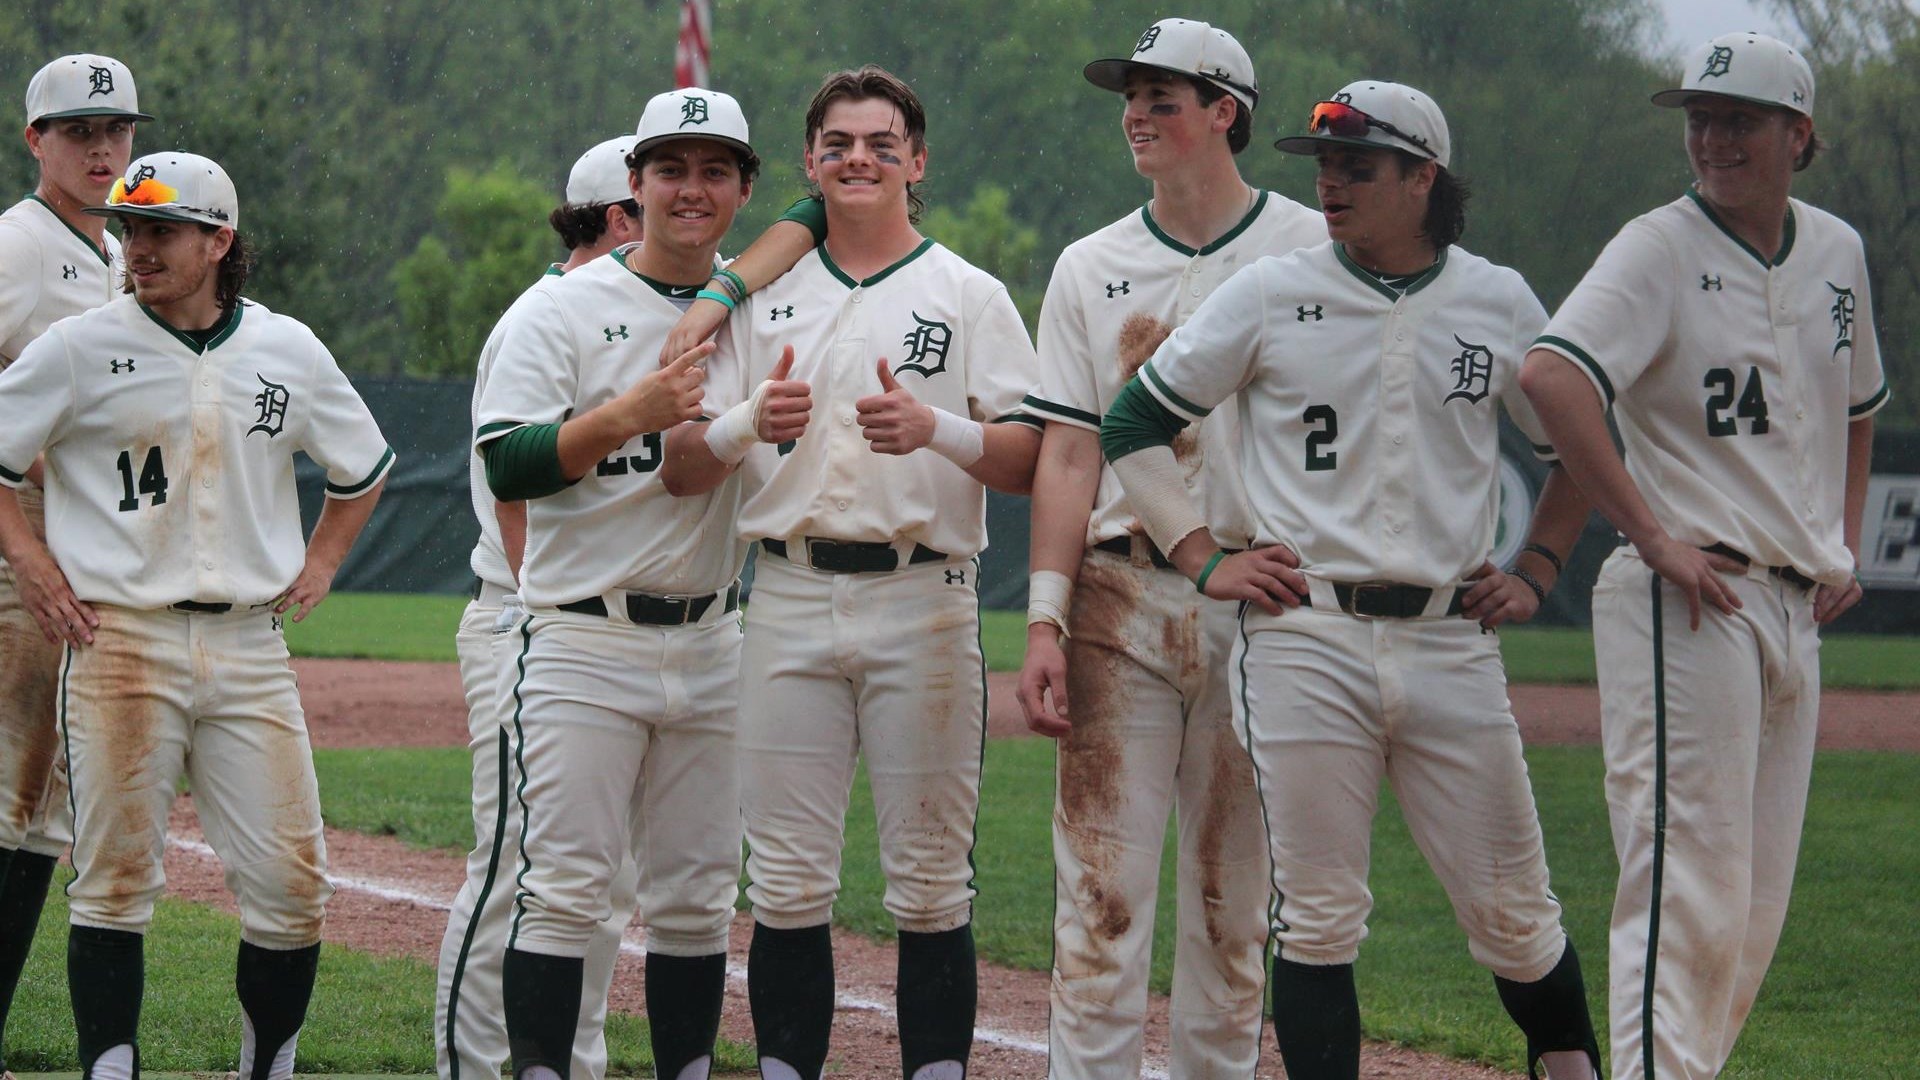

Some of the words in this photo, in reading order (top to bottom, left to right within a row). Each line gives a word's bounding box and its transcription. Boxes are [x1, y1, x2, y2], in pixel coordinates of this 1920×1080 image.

[88, 65, 115, 100] D
[1699, 46, 1734, 82] D
[679, 96, 710, 130] D
[893, 310, 953, 380] D
[1443, 333, 1494, 407] D
[246, 372, 290, 439] D
[1703, 365, 1770, 438] 24
[1303, 404, 1339, 472] 2
[116, 445, 169, 512] 14
